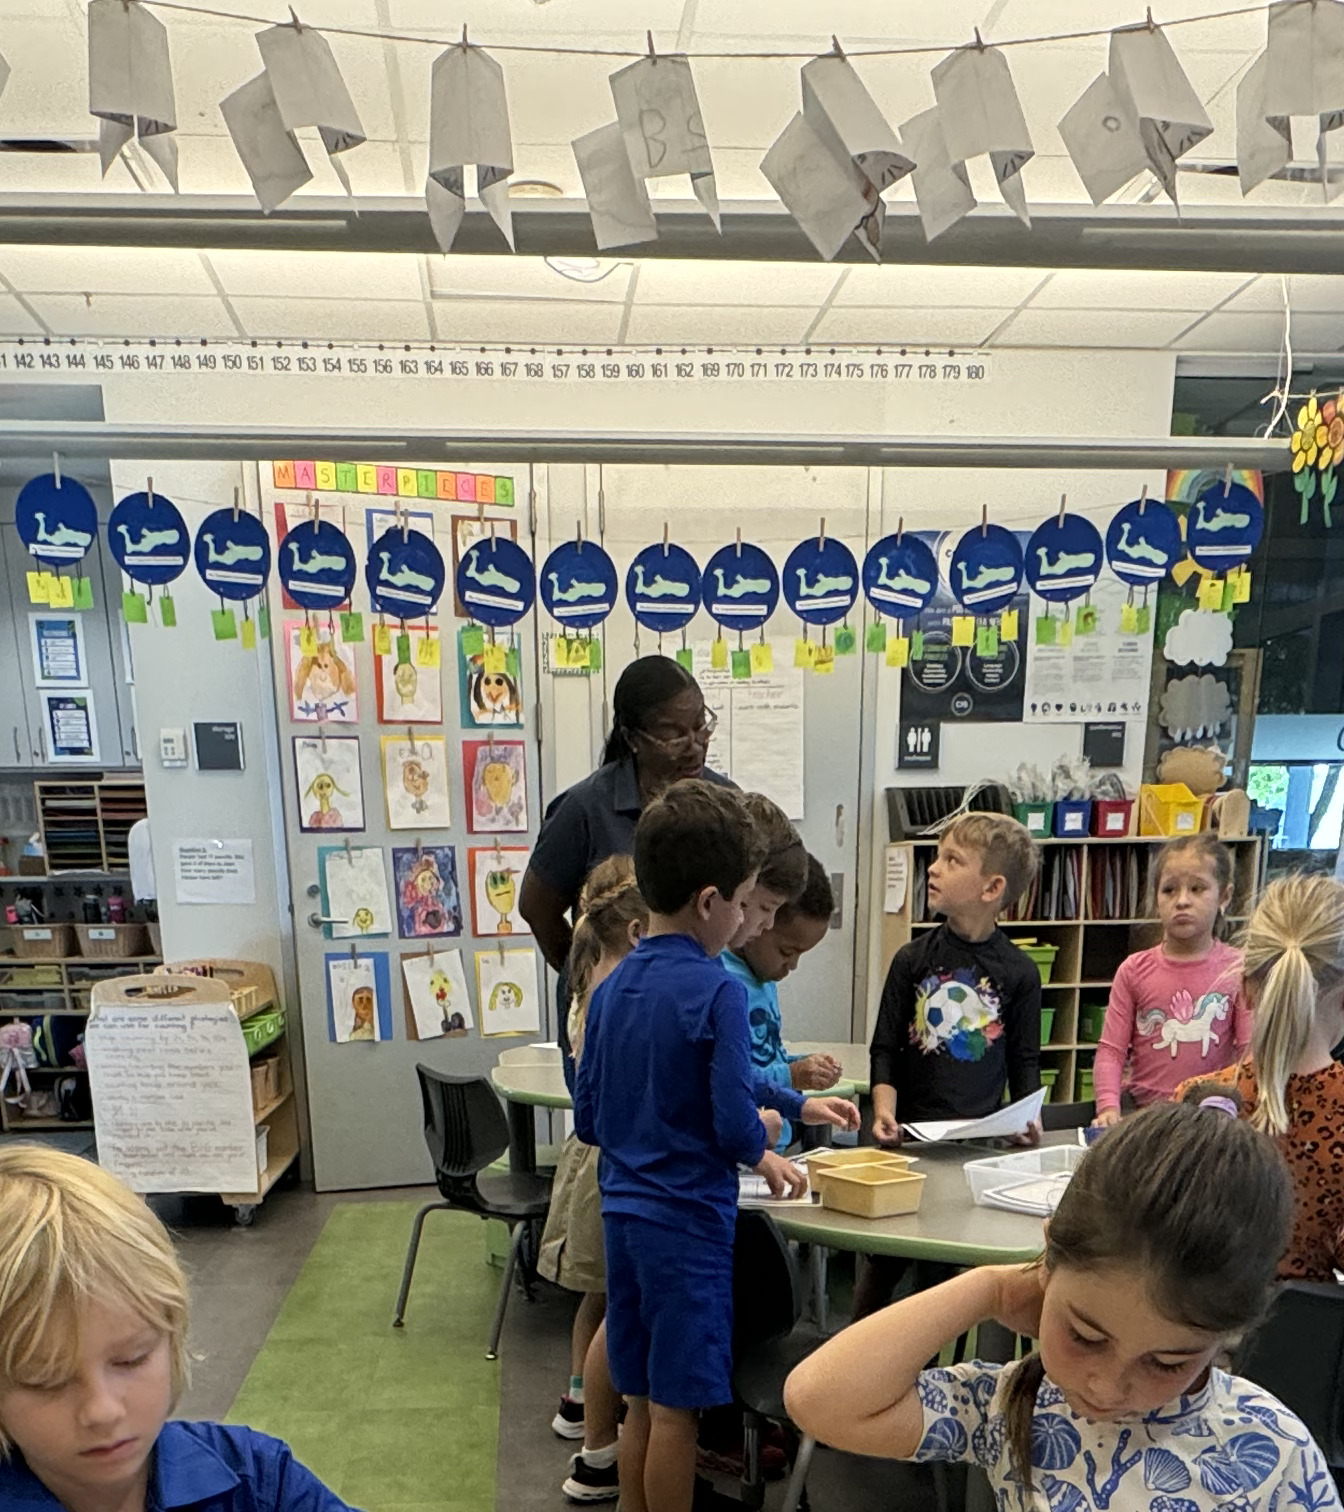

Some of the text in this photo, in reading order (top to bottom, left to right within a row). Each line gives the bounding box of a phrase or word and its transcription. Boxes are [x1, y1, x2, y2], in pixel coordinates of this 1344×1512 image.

[13, 353, 35, 368] 142
[38, 354, 61, 368] 143
[92, 354, 114, 369] 145
[144, 354, 165, 369] 147
[170, 354, 191, 369] 148
[221, 355, 242, 370] 150
[246, 355, 265, 370] 151
[271, 355, 292, 371] 152
[372, 357, 393, 373] 156
[398, 358, 419, 374] 163
[423, 360, 444, 375] 164
[500, 361, 519, 377] 167
[524, 362, 544, 378] 168
[551, 363, 570, 379] 157
[626, 363, 645, 378] 160
[700, 362, 720, 377] 169
[725, 362, 744, 377] 170
[799, 363, 818, 378] 173
[845, 363, 864, 378] 175
[869, 363, 888, 379] 176
[918, 364, 937, 379] 178
[942, 365, 961, 379] 179
[966, 365, 985, 380] 180
[276, 466, 510, 499] MASTERPIECES
